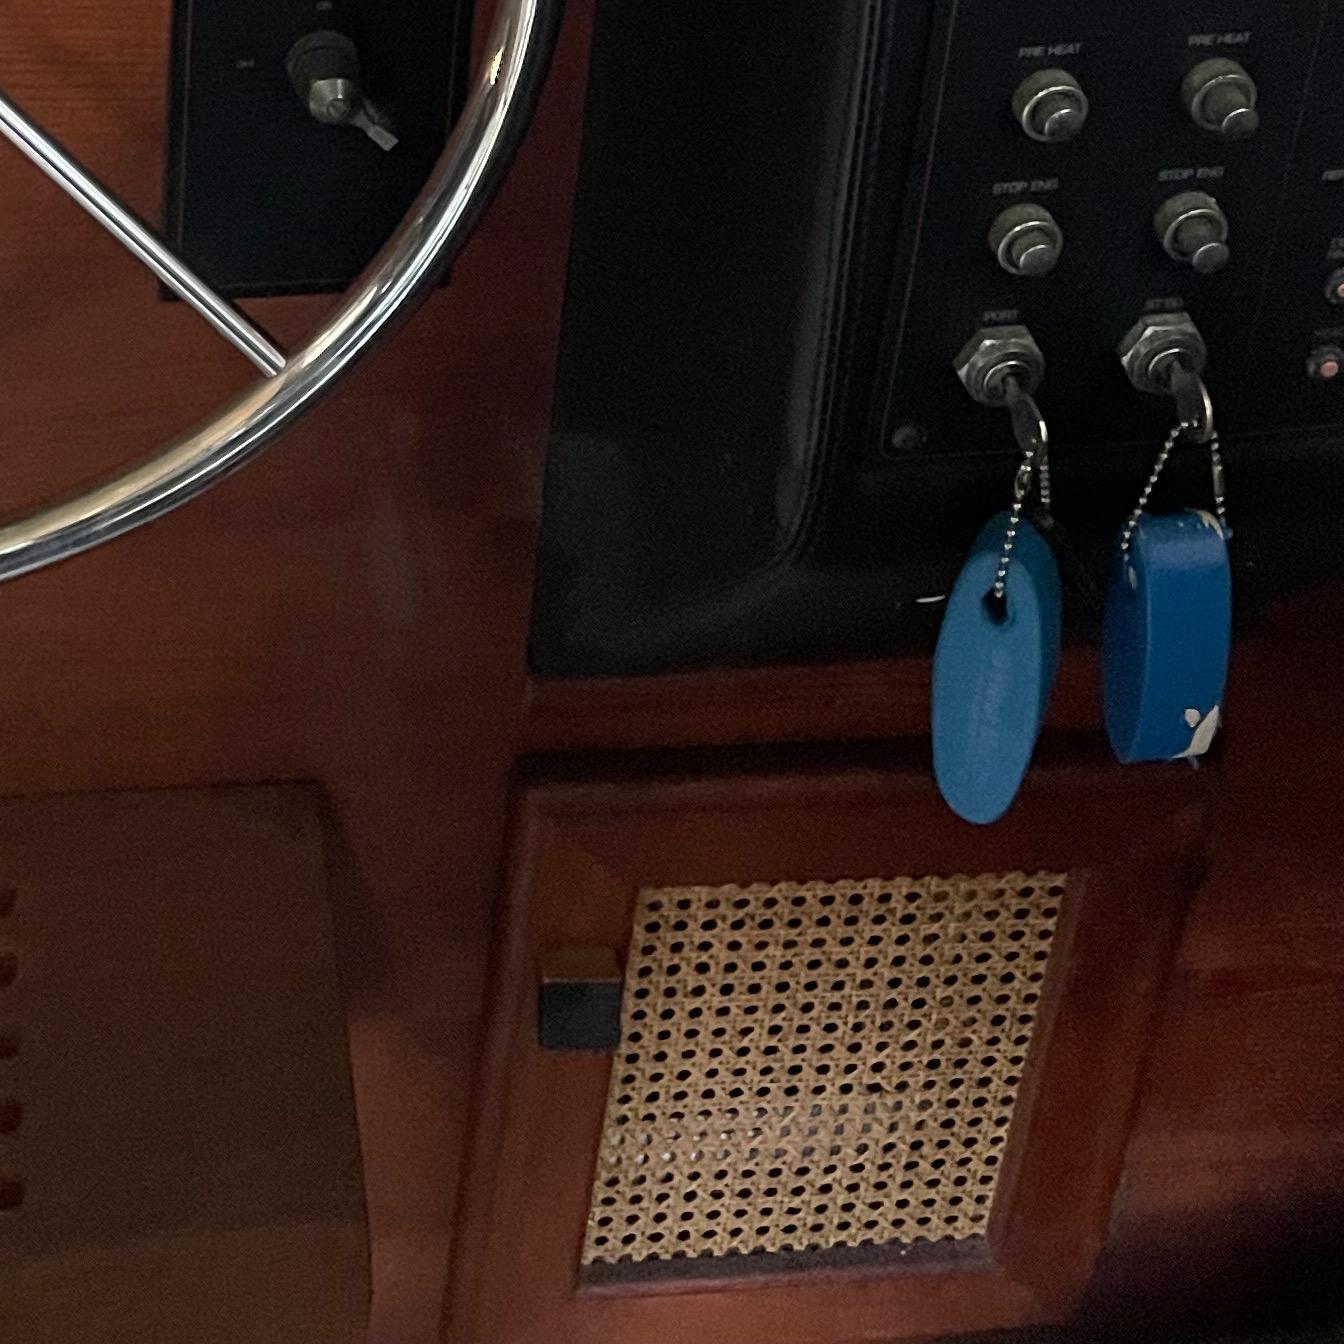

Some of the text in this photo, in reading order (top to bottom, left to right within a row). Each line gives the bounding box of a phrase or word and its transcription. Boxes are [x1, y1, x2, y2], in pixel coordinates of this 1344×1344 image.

[1187, 31, 1252, 47] PRE HEAT
[1018, 42, 1083, 58] PRE HEAT
[1158, 168, 1194, 182] STOP
[992, 180, 1027, 195] STOP
